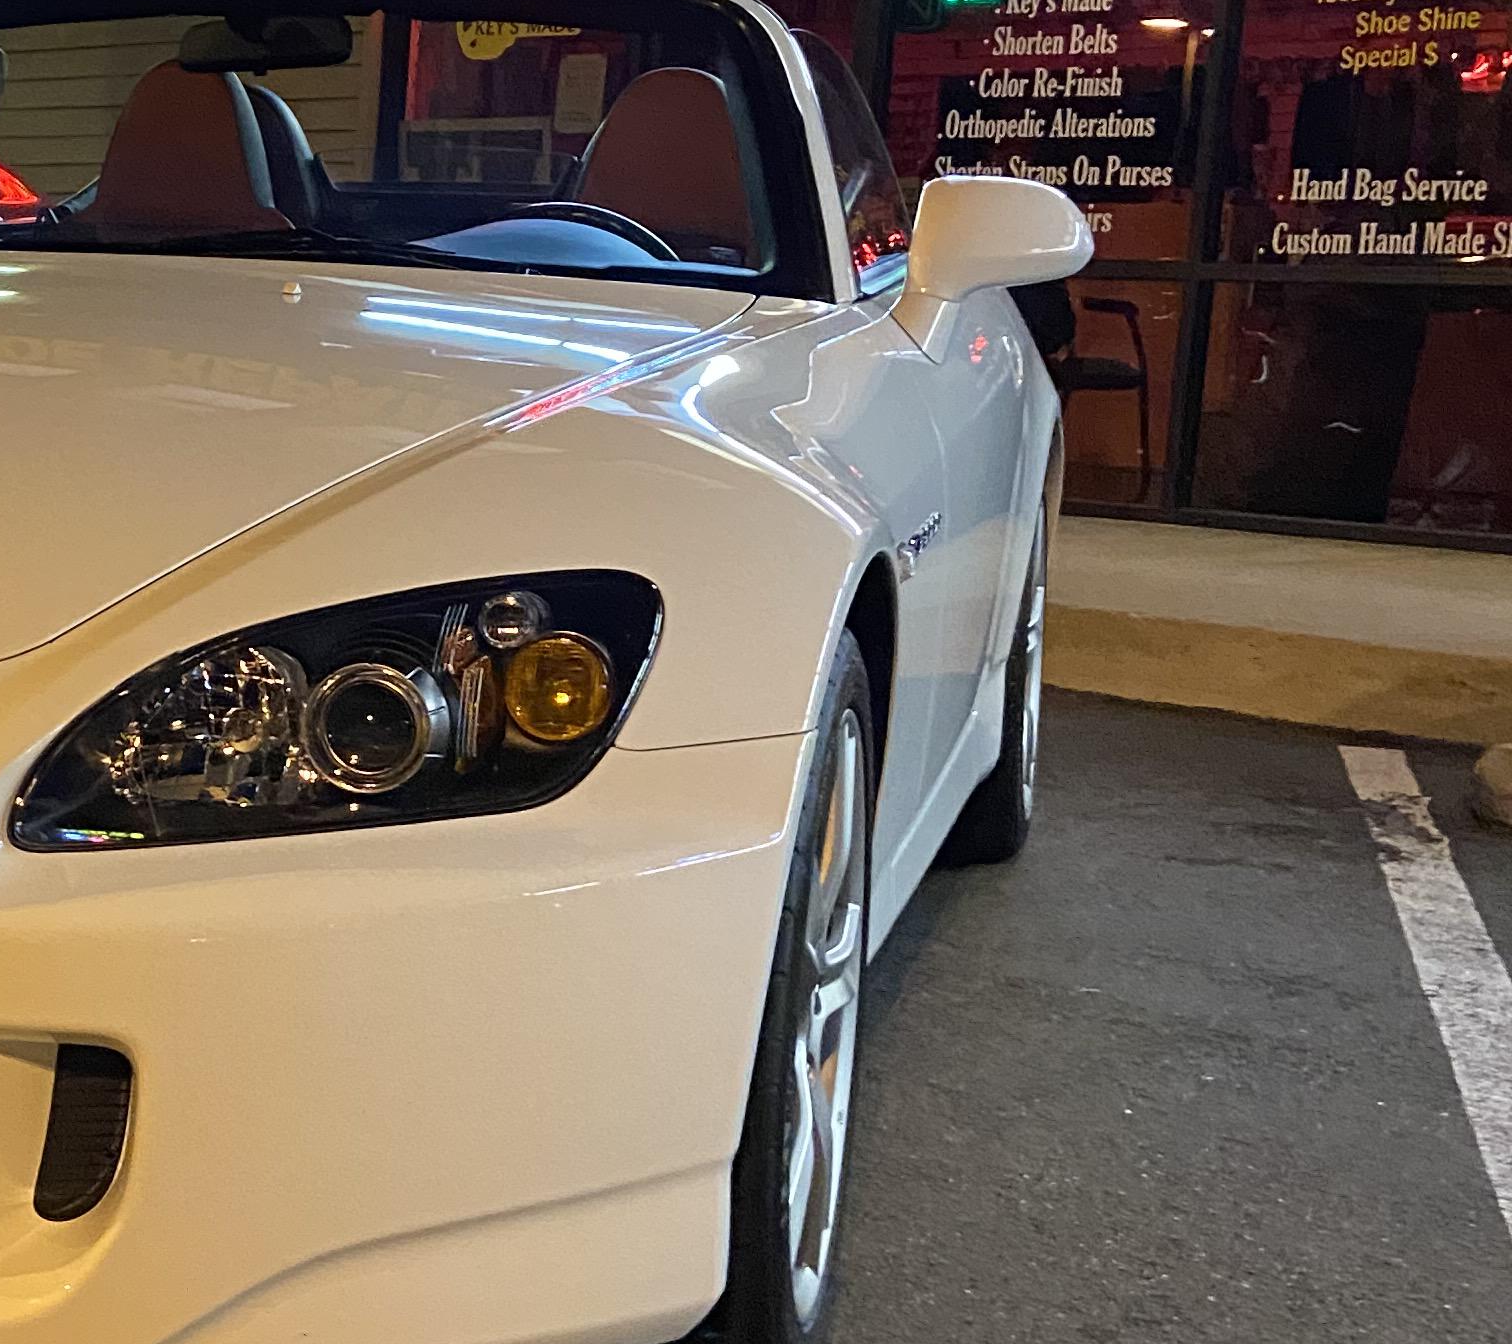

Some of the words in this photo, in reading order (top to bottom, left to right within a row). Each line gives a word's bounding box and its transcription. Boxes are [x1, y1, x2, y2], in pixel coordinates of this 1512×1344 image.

[1355, 10, 1411, 38] Shoe
[1418, 6, 1481, 32] Shine
[992, 26, 1064, 56] Shorten
[1068, 23, 1119, 54] Belts
[1340, 41, 1417, 76] Special
[978, 67, 1029, 98] Color
[1032, 65, 1123, 97] Re-Finish
[945, 108, 1045, 143] Orthopedic
[1049, 107, 1156, 139] Alterations
[1072, 155, 1100, 186] On
[1104, 155, 1174, 187] Purses
[1290, 168, 1349, 201] Hand
[1353, 168, 1398, 206] Bag
[1402, 168, 1488, 201] Service
[1272, 222, 1352, 255] Custom
[1358, 222, 1417, 255] Hand
[1422, 221, 1485, 255] Made
